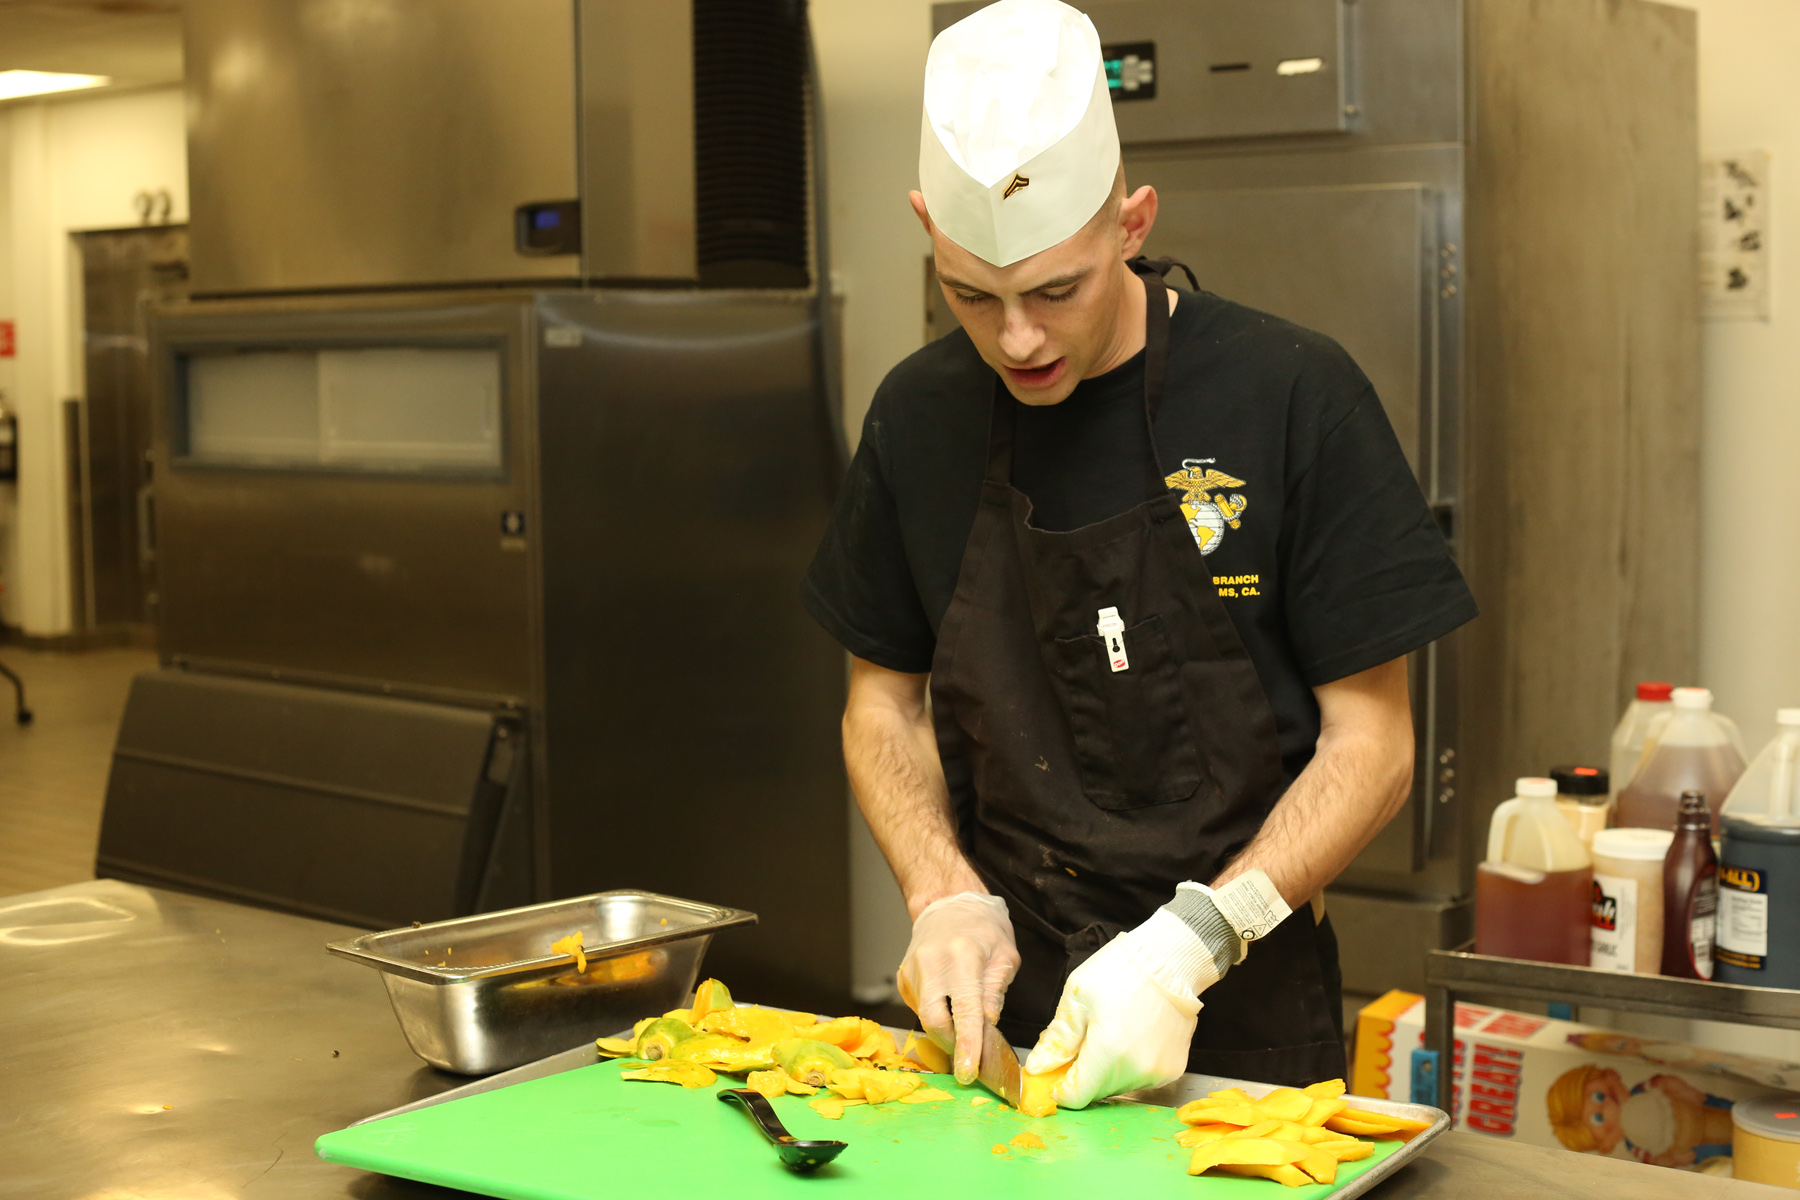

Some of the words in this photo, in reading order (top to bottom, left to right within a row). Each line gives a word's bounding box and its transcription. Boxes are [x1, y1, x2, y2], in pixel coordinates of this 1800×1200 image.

[1212, 574, 1259, 585] BRANCH
[1218, 587, 1239, 599] MS,
[1241, 587, 1260, 596] CA.
[1466, 1043, 1523, 1136] GREAT!
